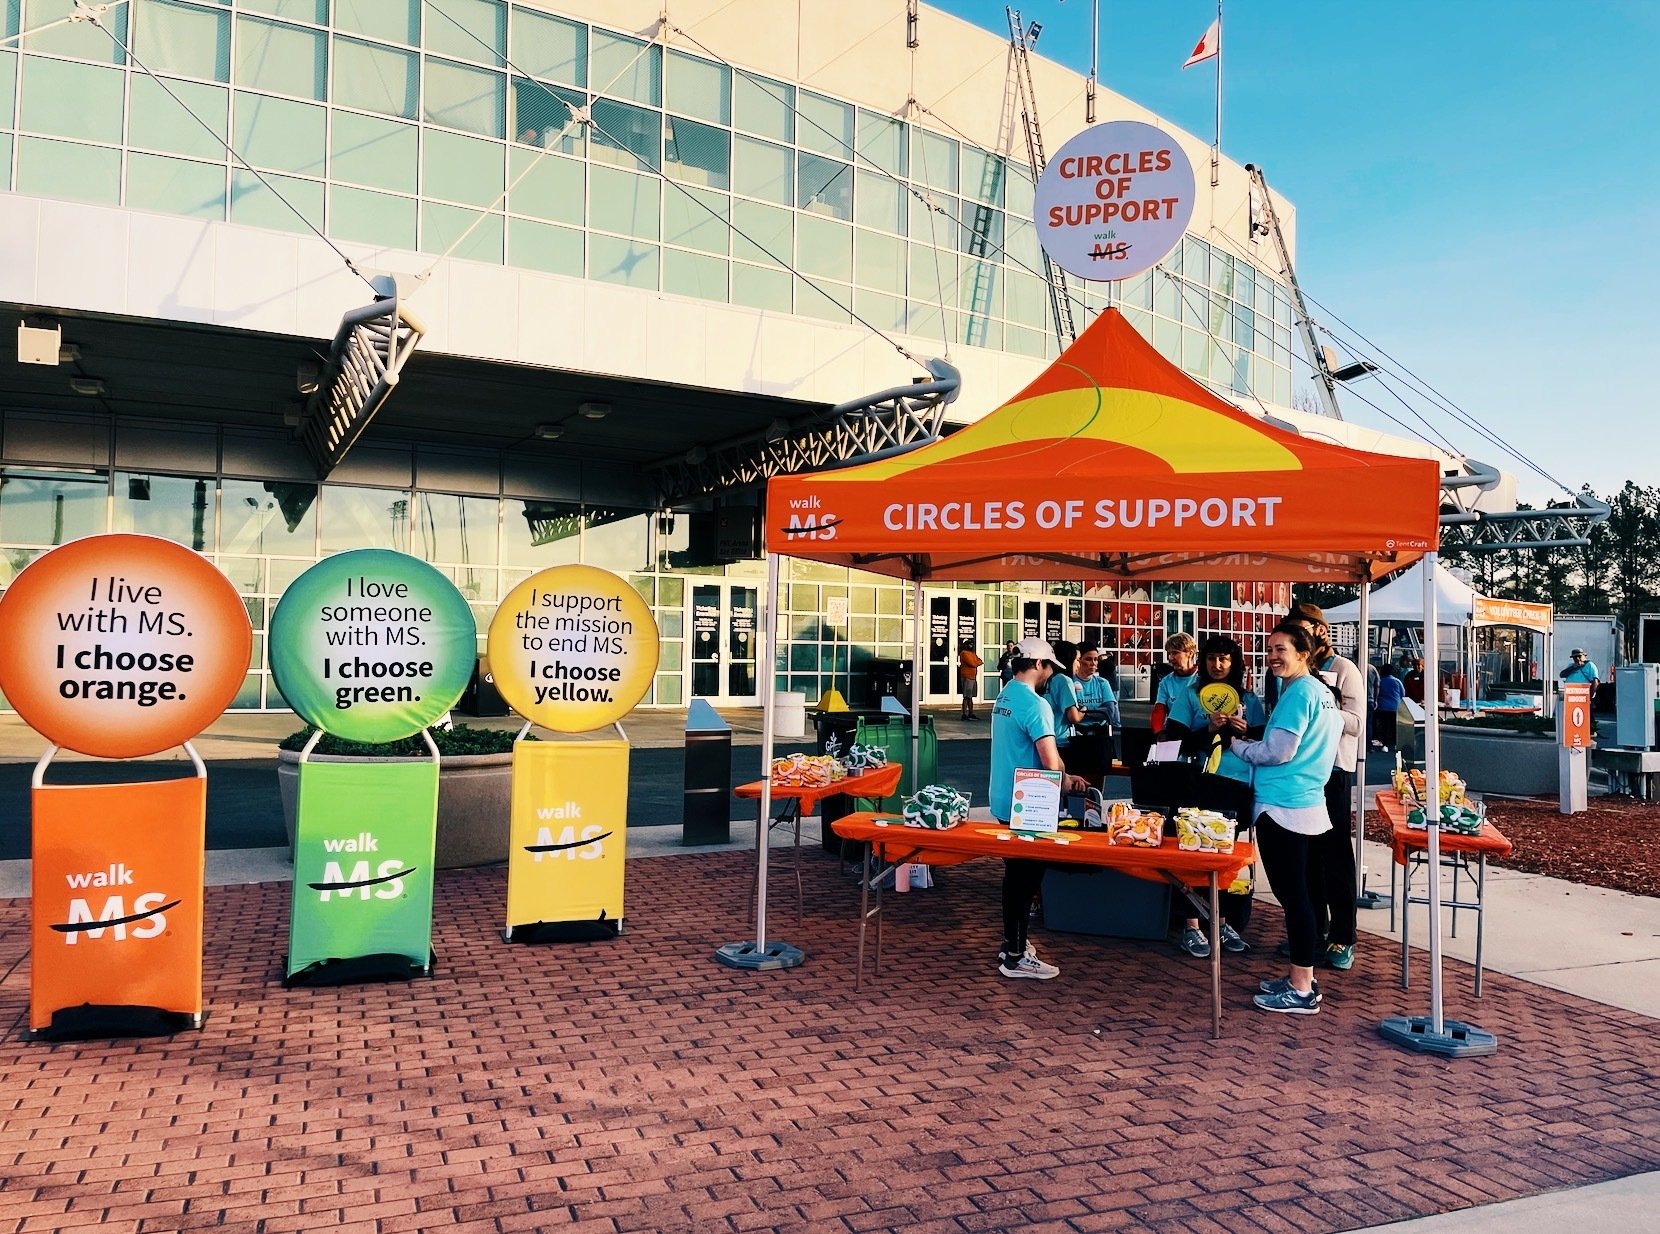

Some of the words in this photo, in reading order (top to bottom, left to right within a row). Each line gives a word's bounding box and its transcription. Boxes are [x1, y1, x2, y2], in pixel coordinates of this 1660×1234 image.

[1059, 149, 1172, 180] CIRCLES
[1095, 177, 1132, 200] OF
[1047, 197, 1179, 228] SUPPORT
[1094, 230, 1117, 241] walk
[789, 496, 822, 510] walk
[883, 501, 1026, 531] CIRCLES
[1036, 500, 1085, 529] OF
[1094, 496, 1283, 528] SUPPORT
[90, 577, 98, 601] I
[108, 576, 162, 604] live
[347, 577, 353, 597] I
[360, 576, 409, 599] love
[532, 588, 537, 606] I
[541, 591, 623, 613] support
[57, 606, 128, 634] with
[138, 610, 193, 637] MS.
[320, 606, 432, 623] someone
[516, 610, 550, 630] the
[554, 612, 633, 635] mission
[325, 625, 378, 647] with
[386, 627, 426, 647] MS.
[522, 633, 544, 651] to
[550, 634, 587, 653] end
[593, 636, 628, 655] MS.
[56, 645, 65, 669] I
[74, 644, 194, 673] choose
[324, 658, 331, 679] I
[338, 656, 434, 679] choose
[530, 660, 536, 679] I
[542, 660, 621, 682] choose
[59, 680, 187, 707] orange.
[335, 685, 421, 710] green.
[534, 682, 614, 705] yellow.
[537, 801, 583, 821] walk
[323, 832, 379, 853] walk
[66, 863, 134, 889] walk
